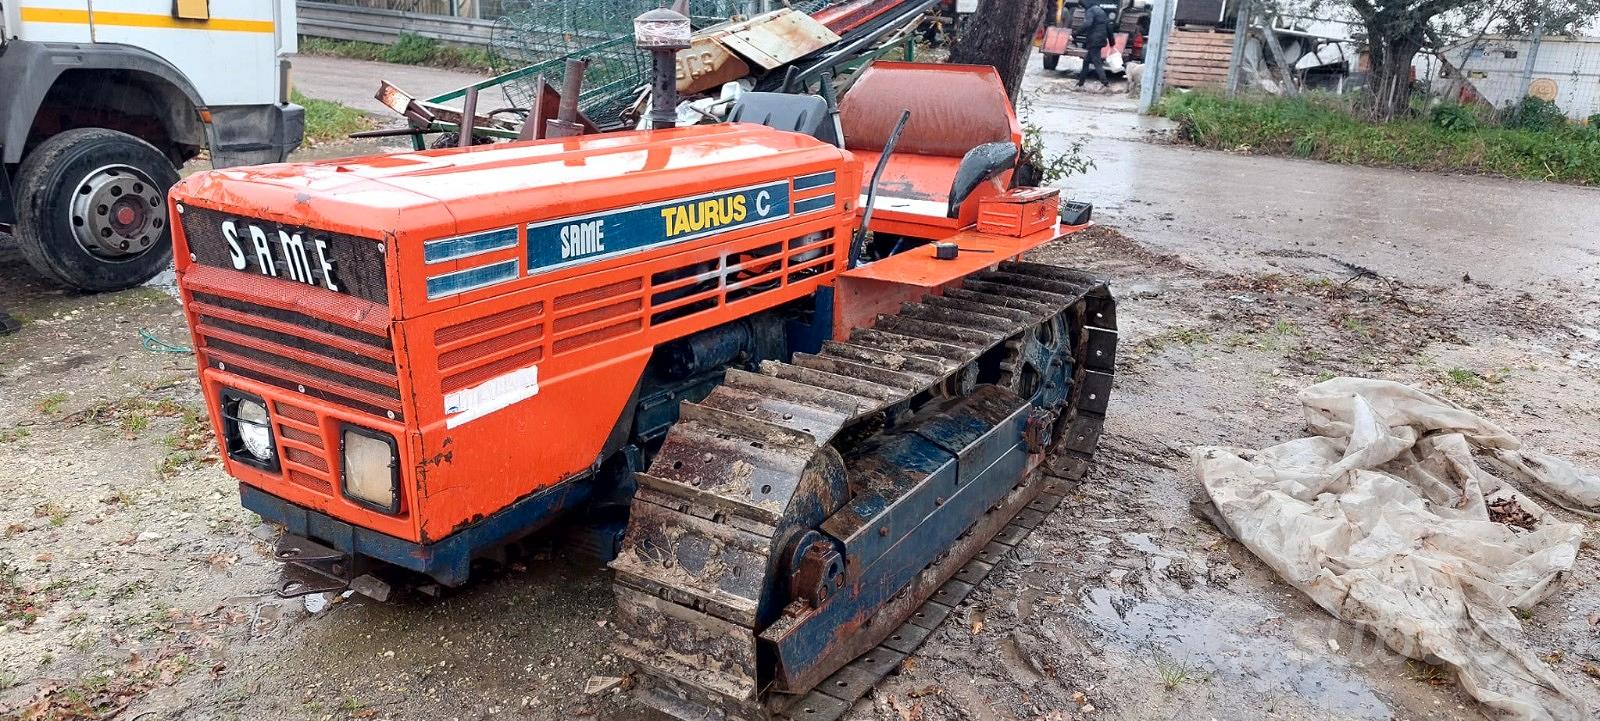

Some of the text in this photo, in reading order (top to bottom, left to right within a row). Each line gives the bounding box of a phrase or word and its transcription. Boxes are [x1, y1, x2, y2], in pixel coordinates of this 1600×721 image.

[221, 220, 338, 292] SAME
[560, 190, 770, 259] SAME TAURUS C
